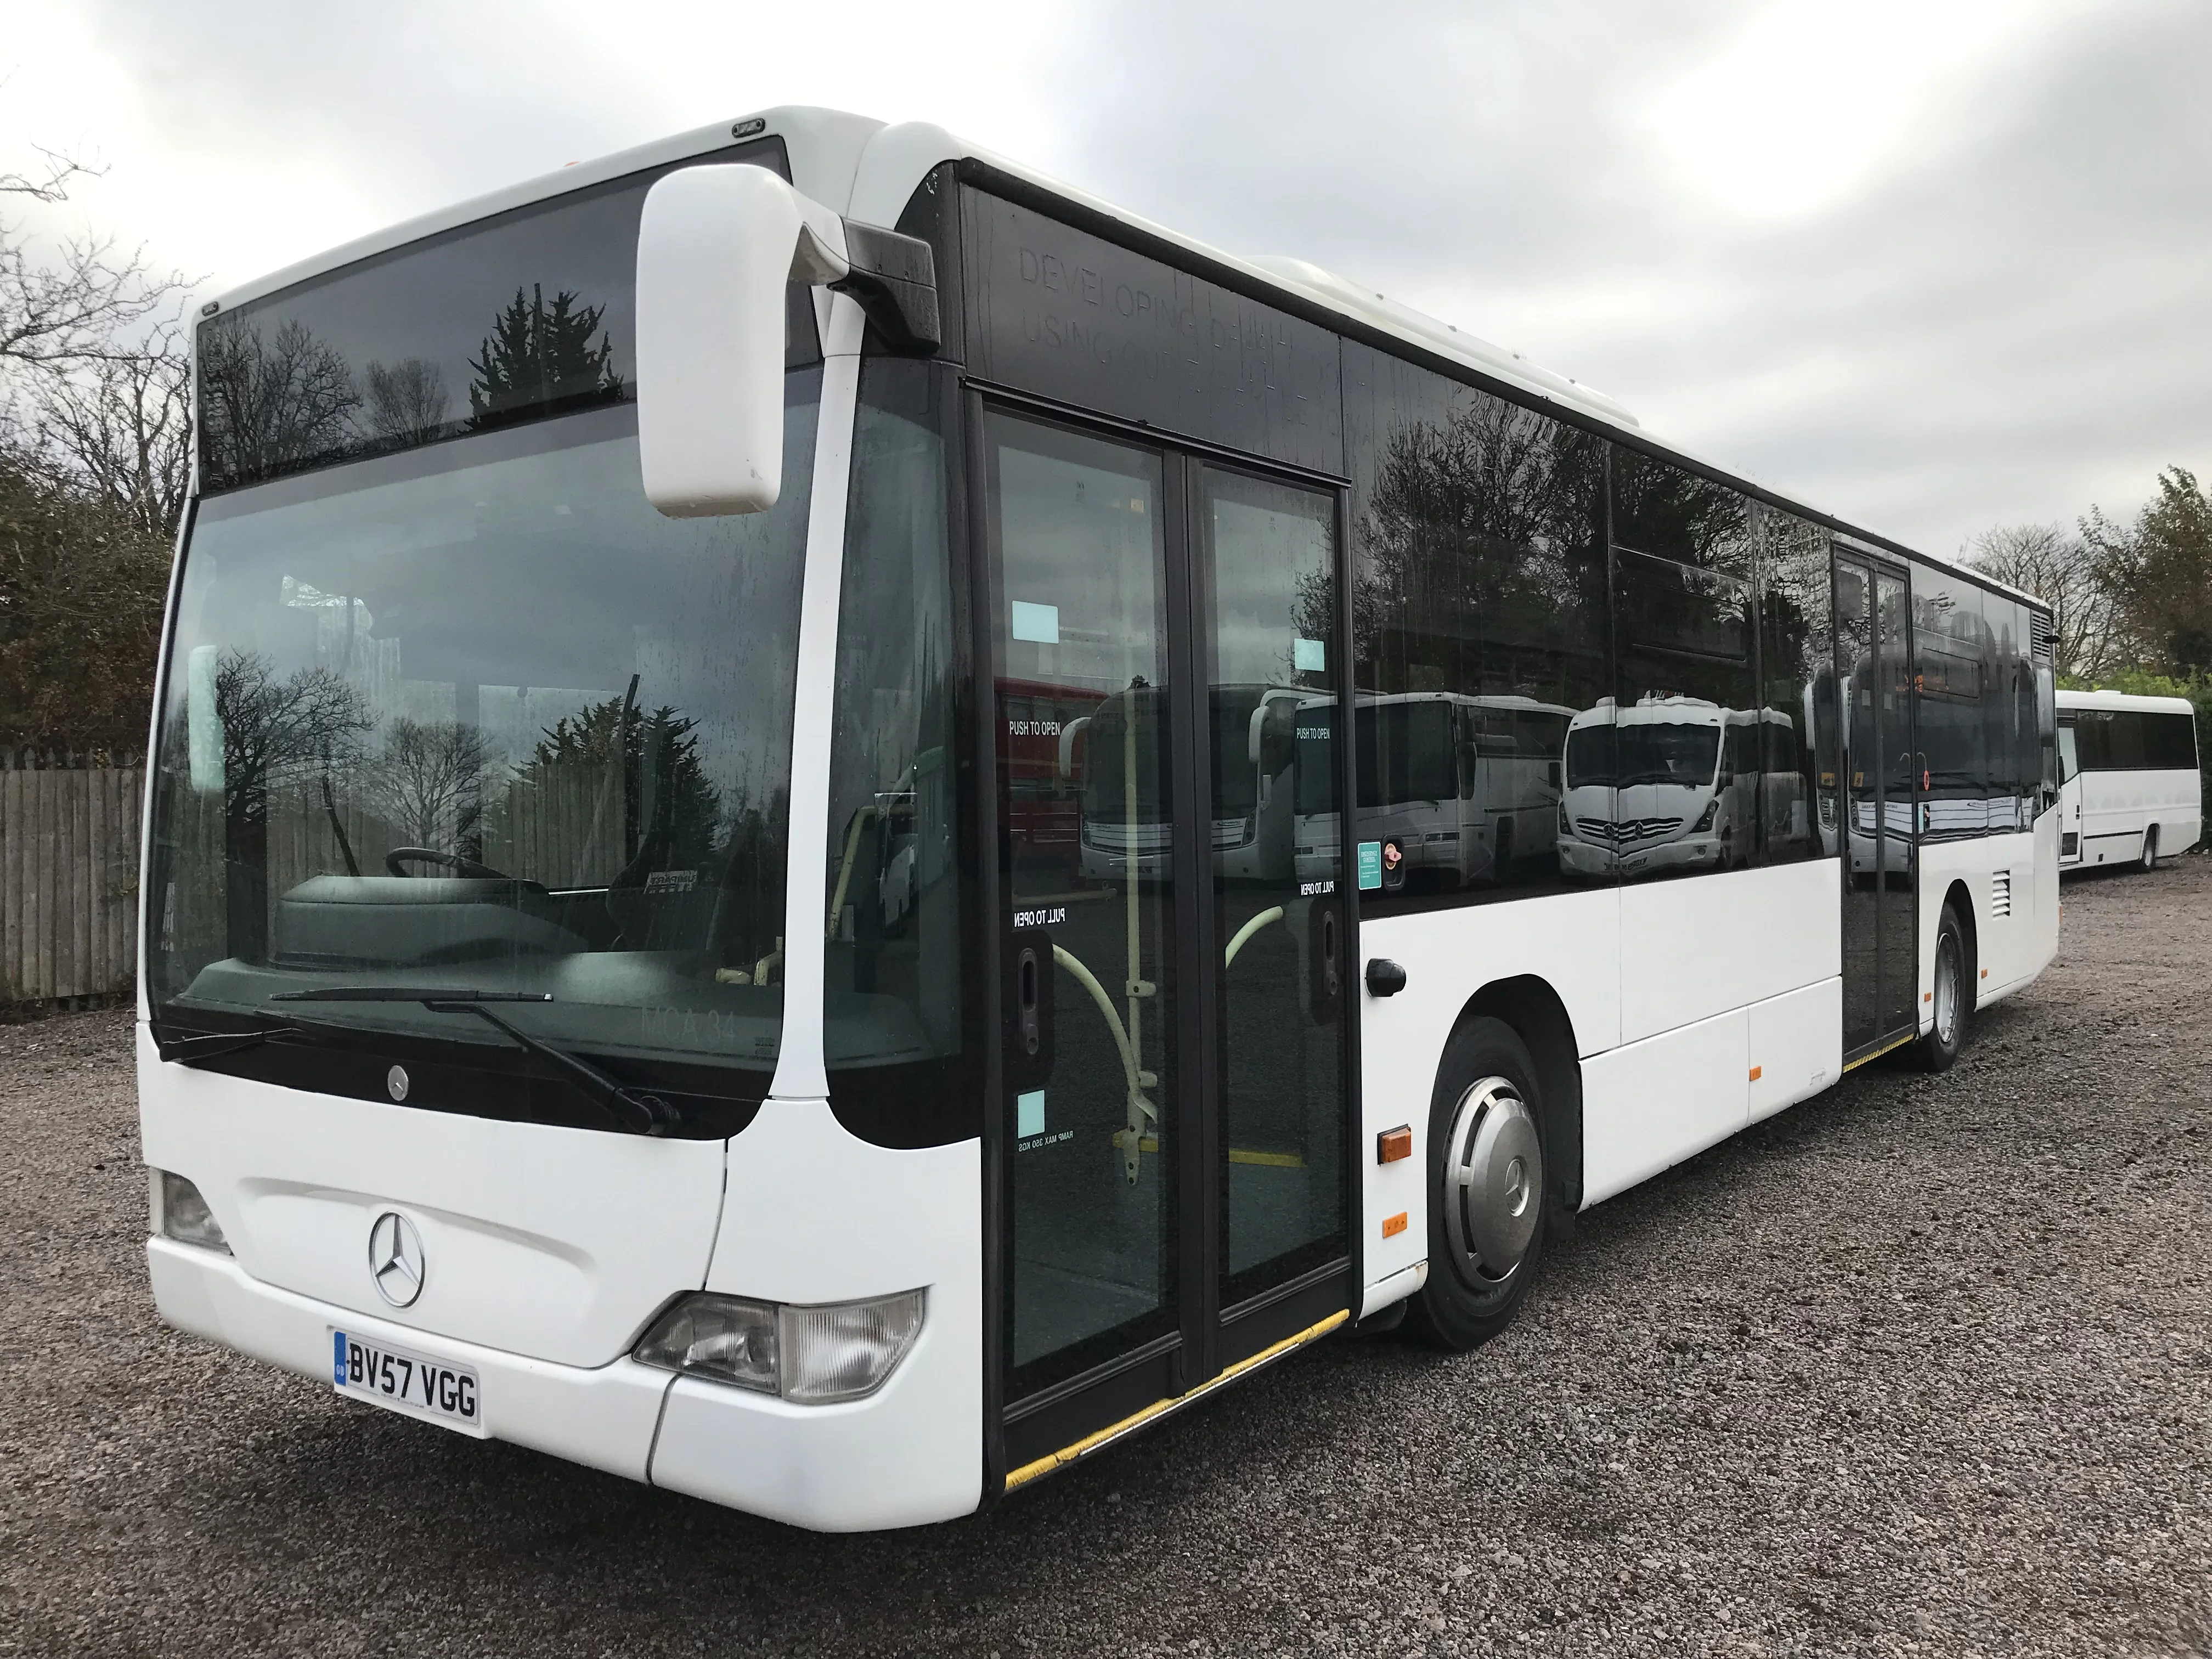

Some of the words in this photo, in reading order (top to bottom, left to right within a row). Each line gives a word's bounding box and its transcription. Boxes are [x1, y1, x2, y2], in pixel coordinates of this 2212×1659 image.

[1009, 721, 1029, 736] PUSH
[1030, 721, 1040, 736] TO
[1041, 721, 1060, 736] OPEN
[1296, 727, 1310, 740] PUSH
[1310, 727, 1317, 740] TO
[1317, 727, 1330, 740] OPEN
[349, 1342, 412, 1398] BV57
[421, 1364, 475, 1417] VGG
